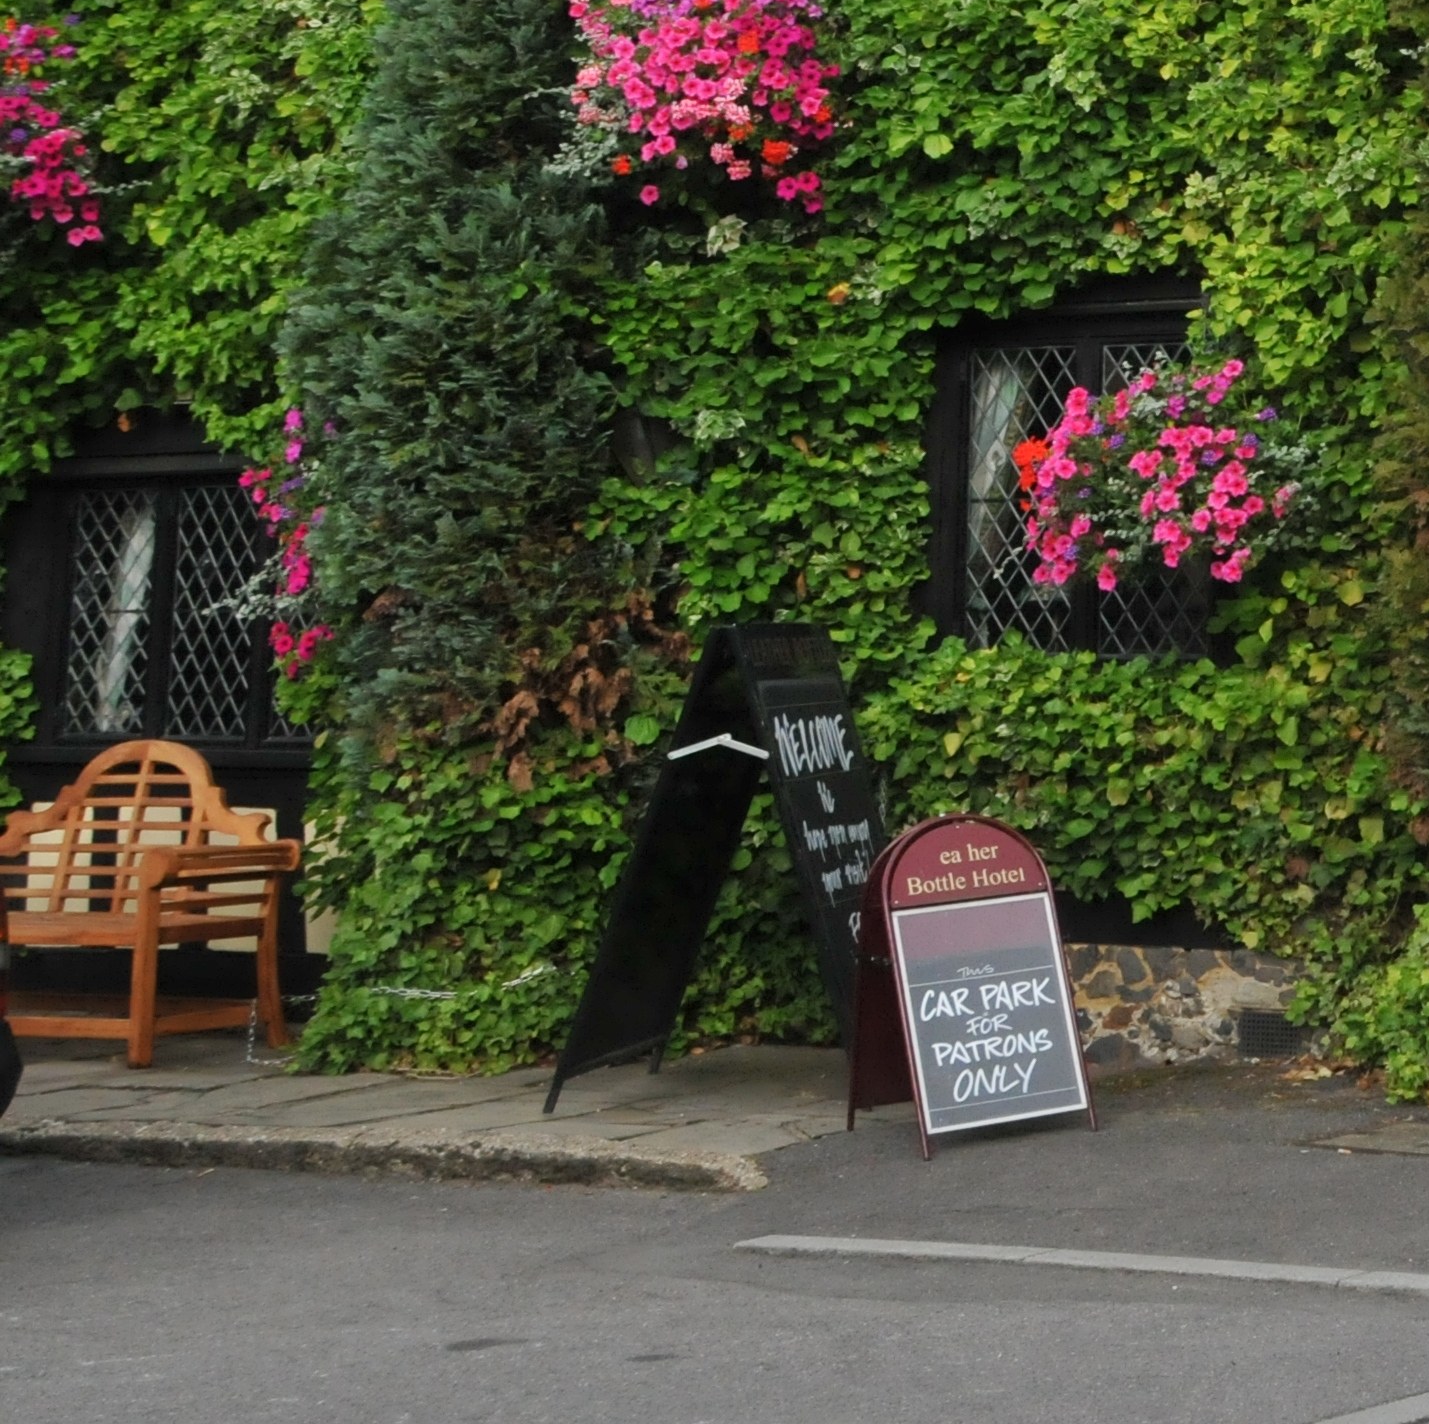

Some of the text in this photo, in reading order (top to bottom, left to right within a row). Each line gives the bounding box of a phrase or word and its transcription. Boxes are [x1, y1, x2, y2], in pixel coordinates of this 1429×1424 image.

[907, 866, 1026, 896] Bottle Hotel
[920, 977, 1056, 1021] CAR PARK
[966, 1013, 1013, 1036] FOR
[931, 1028, 1053, 1066] PATRONS
[953, 1058, 1037, 1103] ONLY
